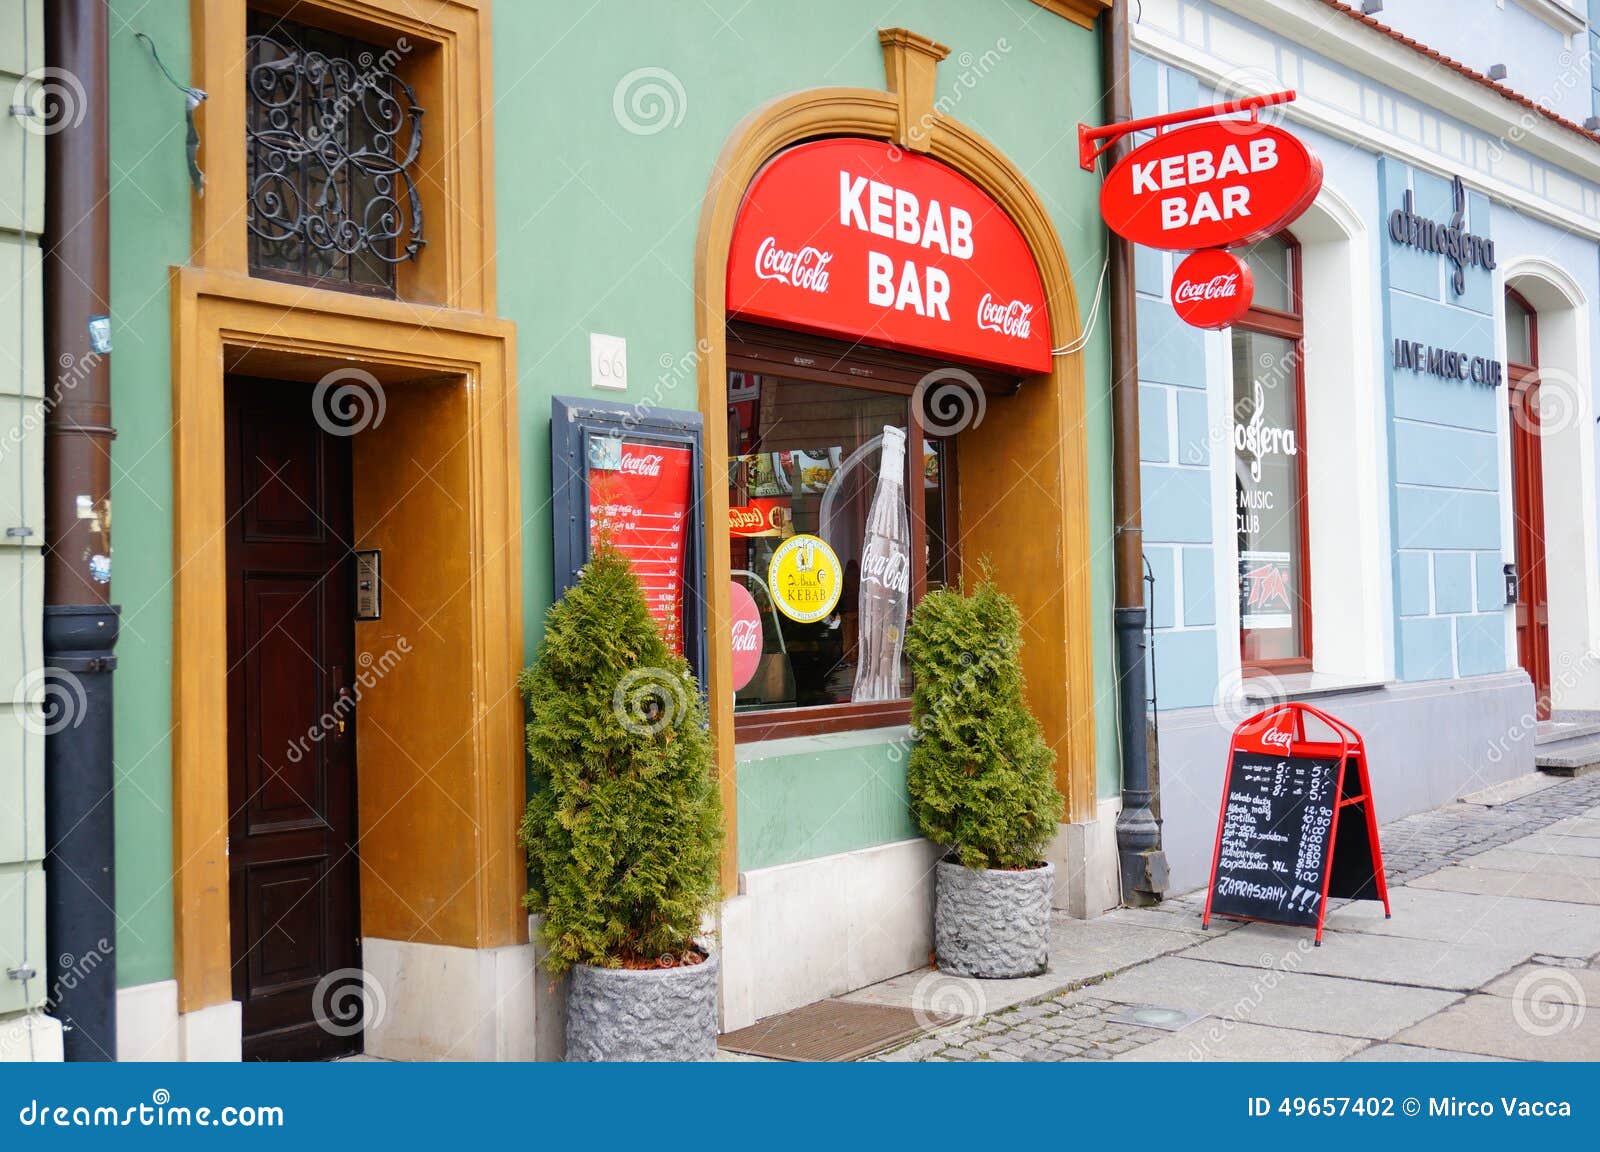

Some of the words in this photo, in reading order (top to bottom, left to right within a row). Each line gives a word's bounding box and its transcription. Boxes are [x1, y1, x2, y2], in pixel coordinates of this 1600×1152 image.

[1131, 137, 1278, 195] KEBAB
[840, 170, 974, 260] KEBAB
[1161, 185, 1251, 230] BAR
[869, 250, 951, 321] BAR
[599, 351, 625, 379] 66
[1394, 338, 1425, 372] LIVE
[1427, 346, 1469, 380] MUSIC
[1470, 356, 1502, 387] CLUB
[1235, 380, 1297, 482] osfera
[1236, 514, 1260, 533] CLUB
[1240, 491, 1273, 509] MUSIC
[788, 589, 826, 601] KEBAB
